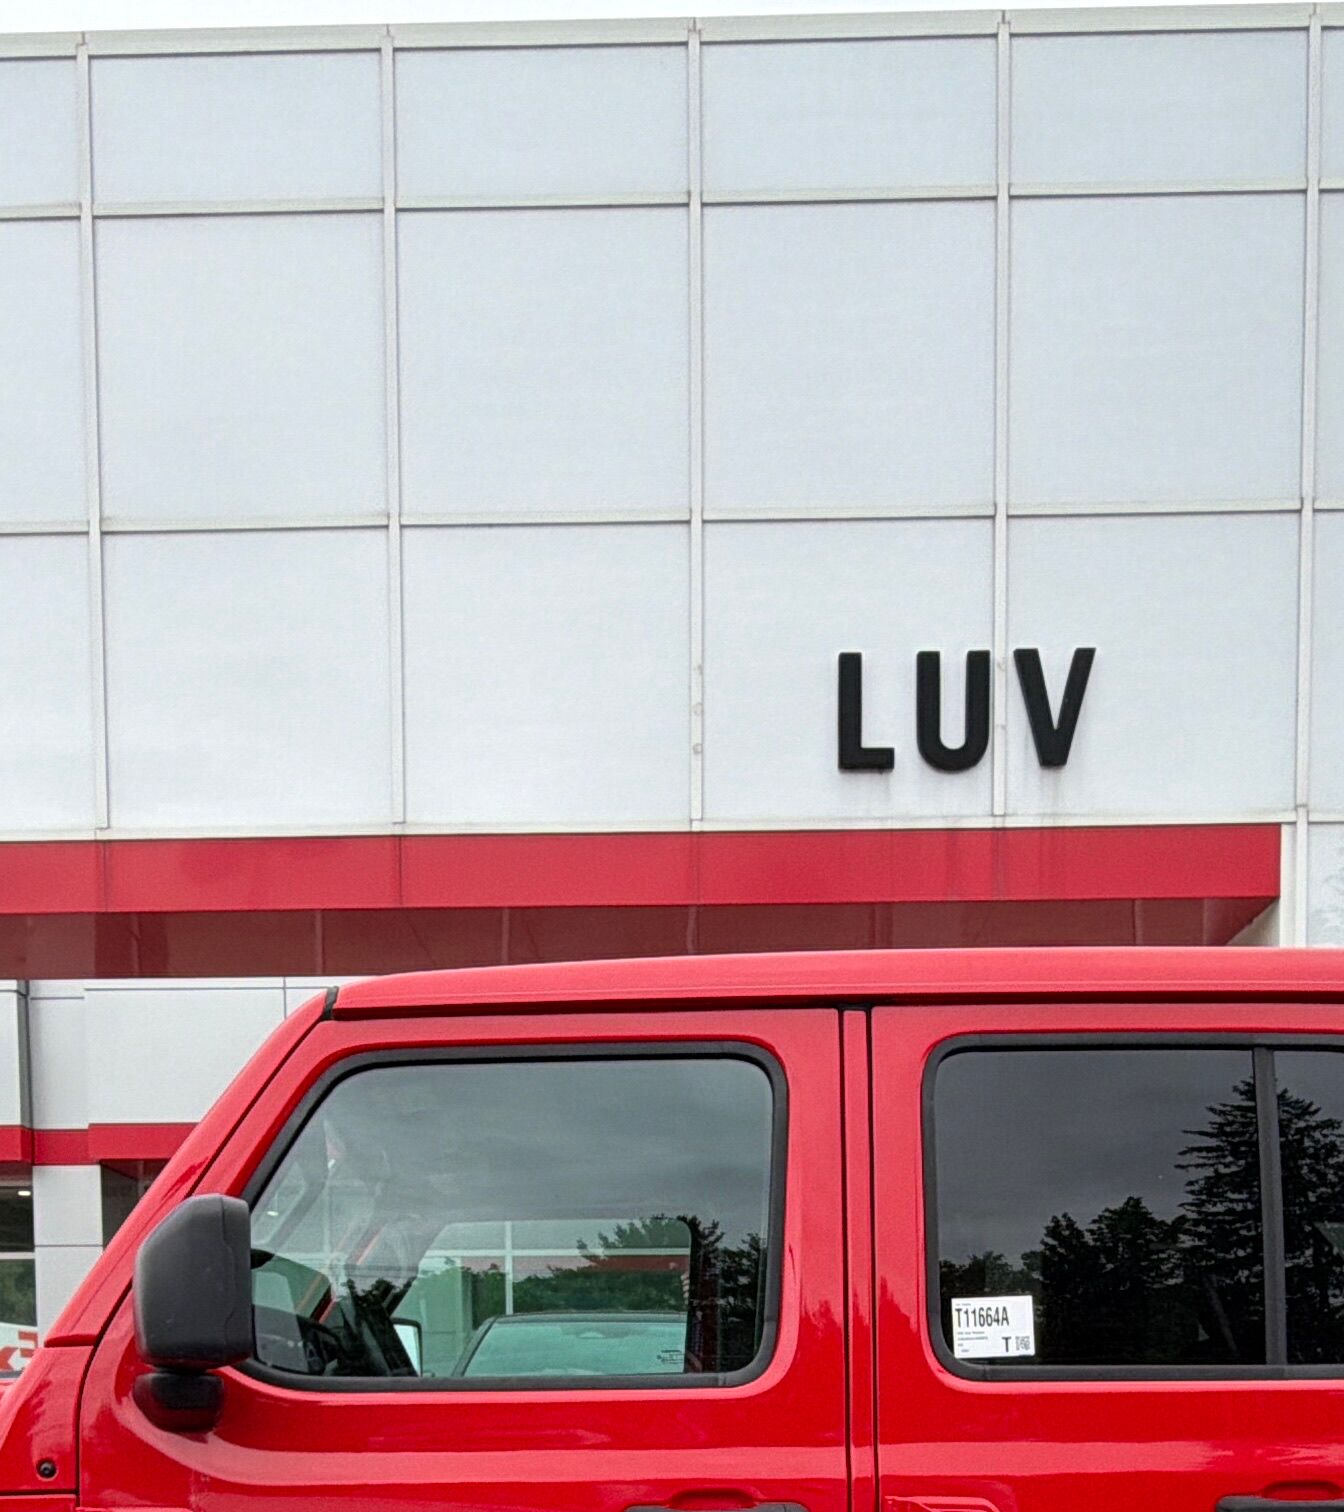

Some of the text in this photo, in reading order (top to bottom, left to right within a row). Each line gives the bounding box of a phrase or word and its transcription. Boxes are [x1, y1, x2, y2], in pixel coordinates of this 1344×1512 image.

[838, 647, 1097, 774] LUV
[955, 1306, 1009, 1328] T11664A
[1001, 1336, 1012, 1353] T
